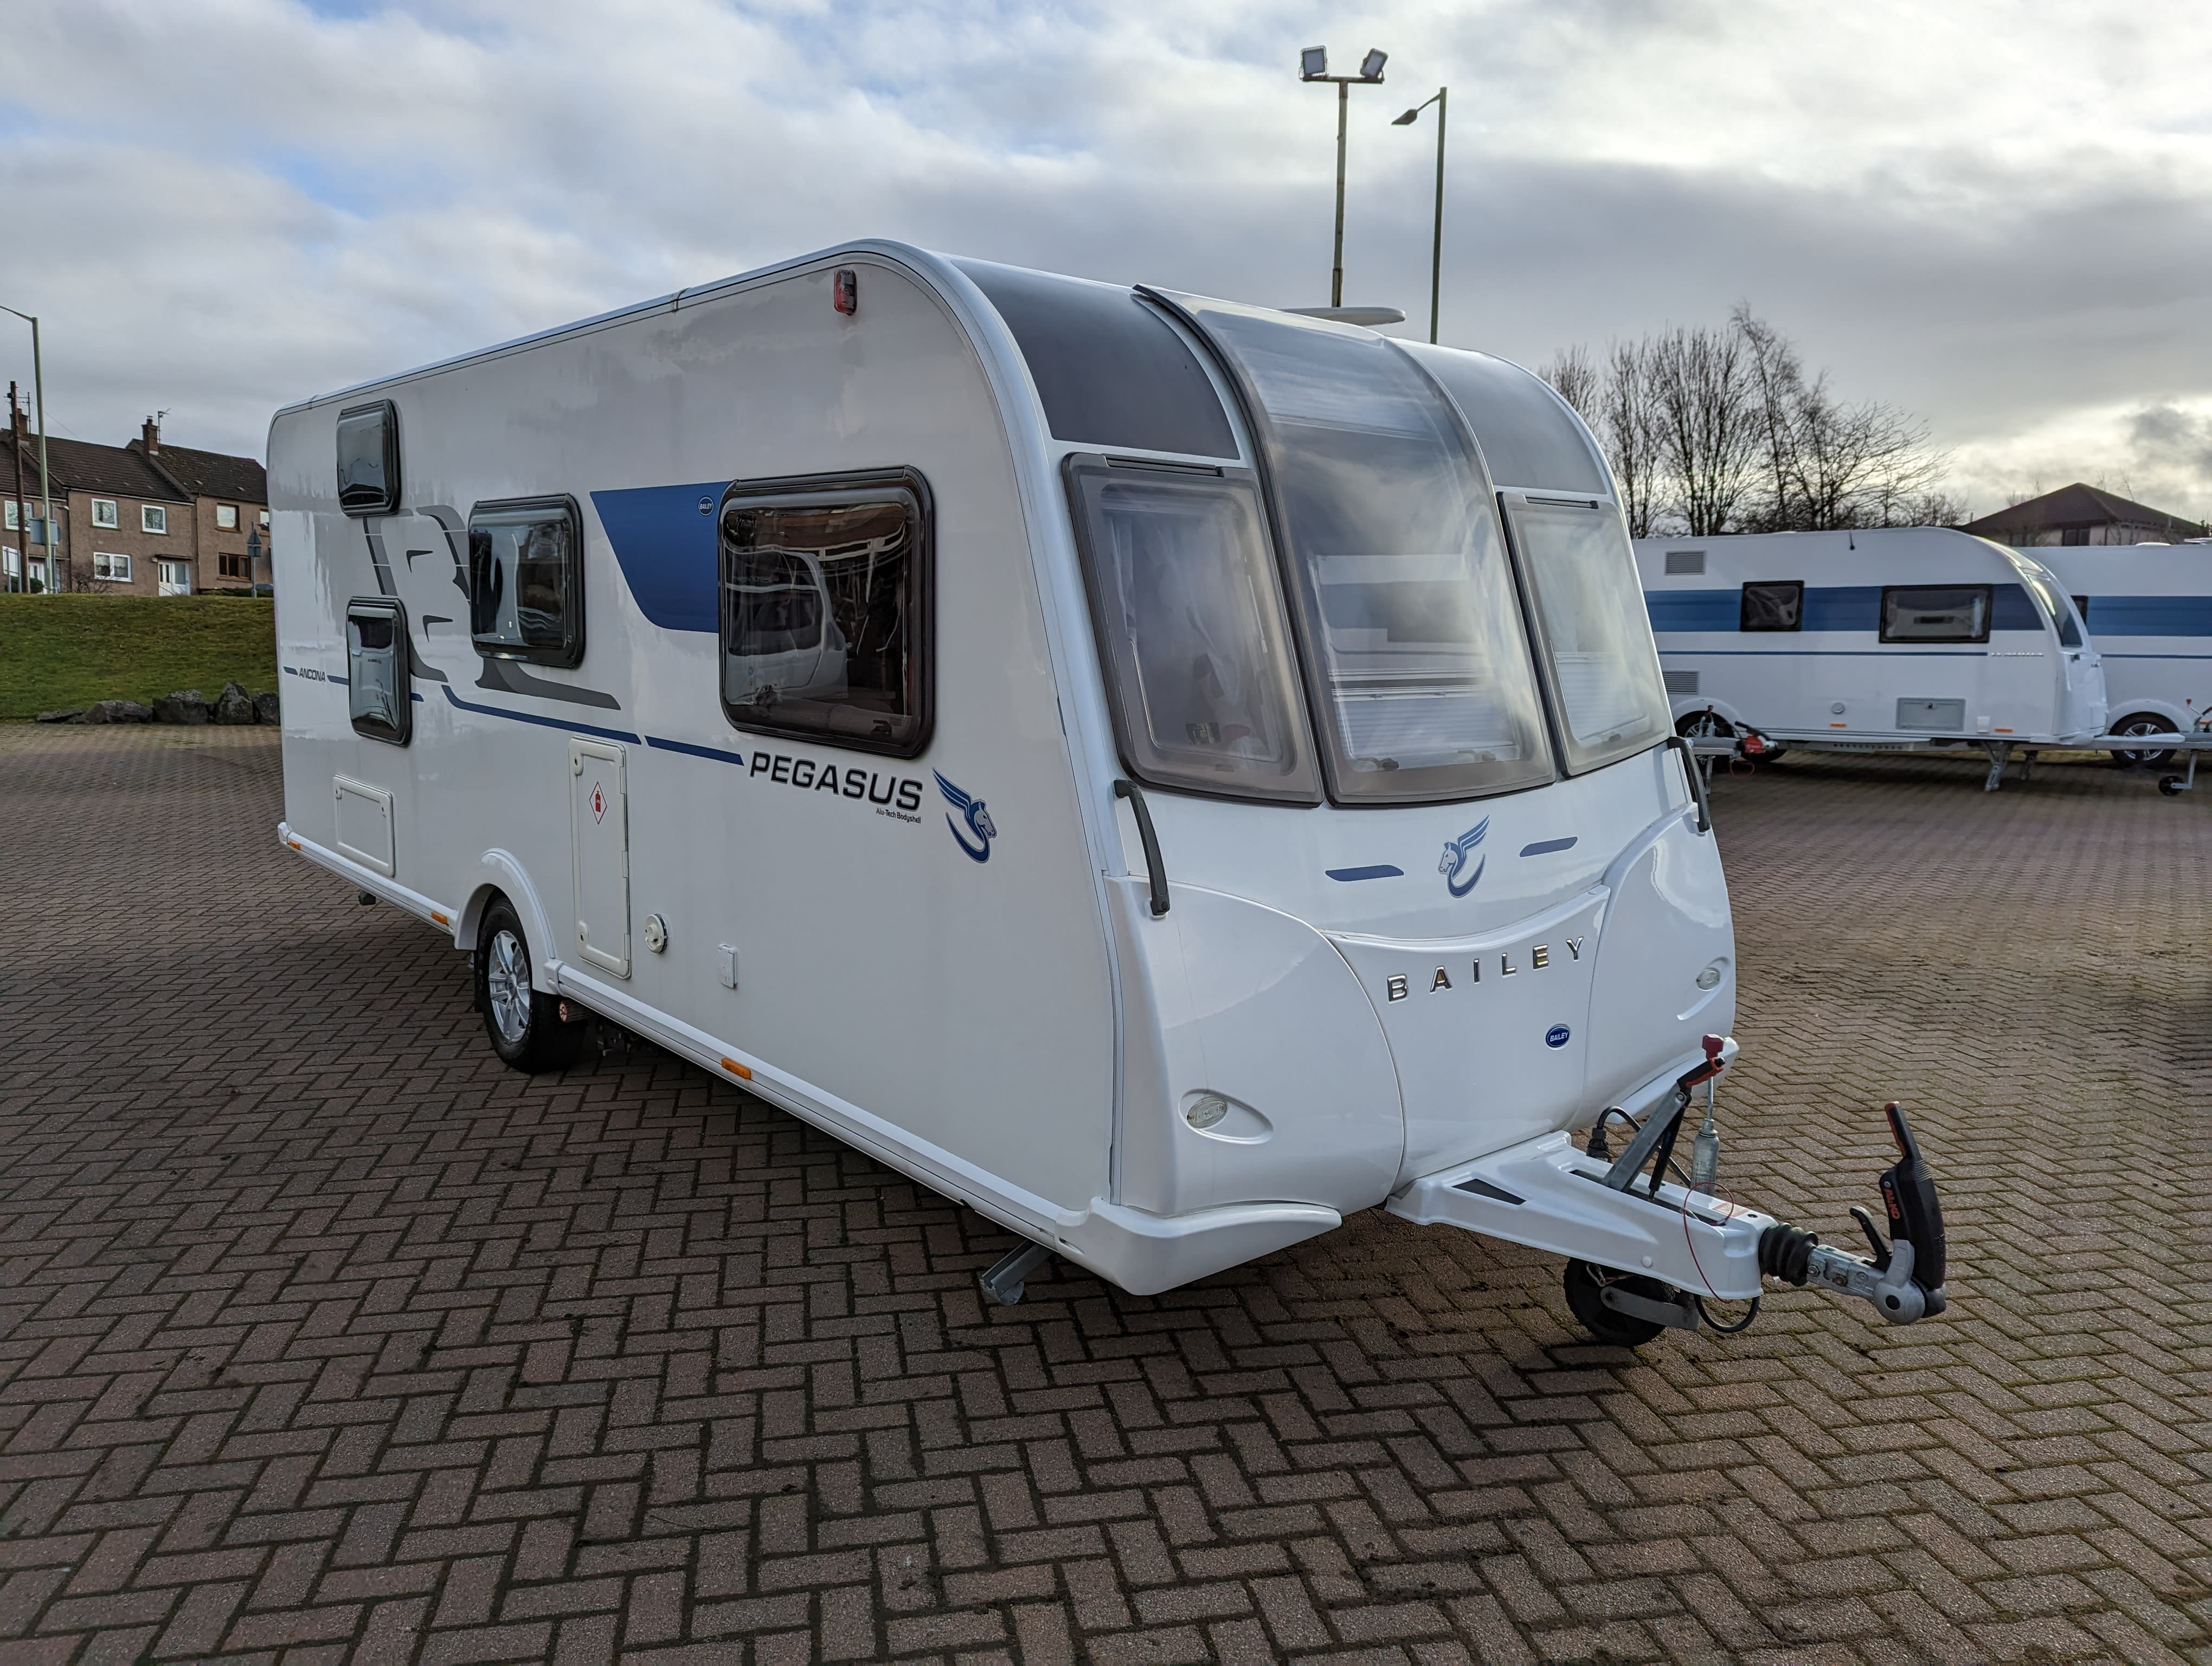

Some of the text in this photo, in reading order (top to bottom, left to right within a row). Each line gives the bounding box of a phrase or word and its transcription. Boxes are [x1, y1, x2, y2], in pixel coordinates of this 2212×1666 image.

[299, 667, 326, 682] ANCONA
[750, 751, 923, 812] PEGASUS
[876, 808, 921, 824] Alu-Tech Bodyshell
[1387, 936, 1584, 1003] BAILEY
[1549, 1031, 1568, 1042] BAILEY
